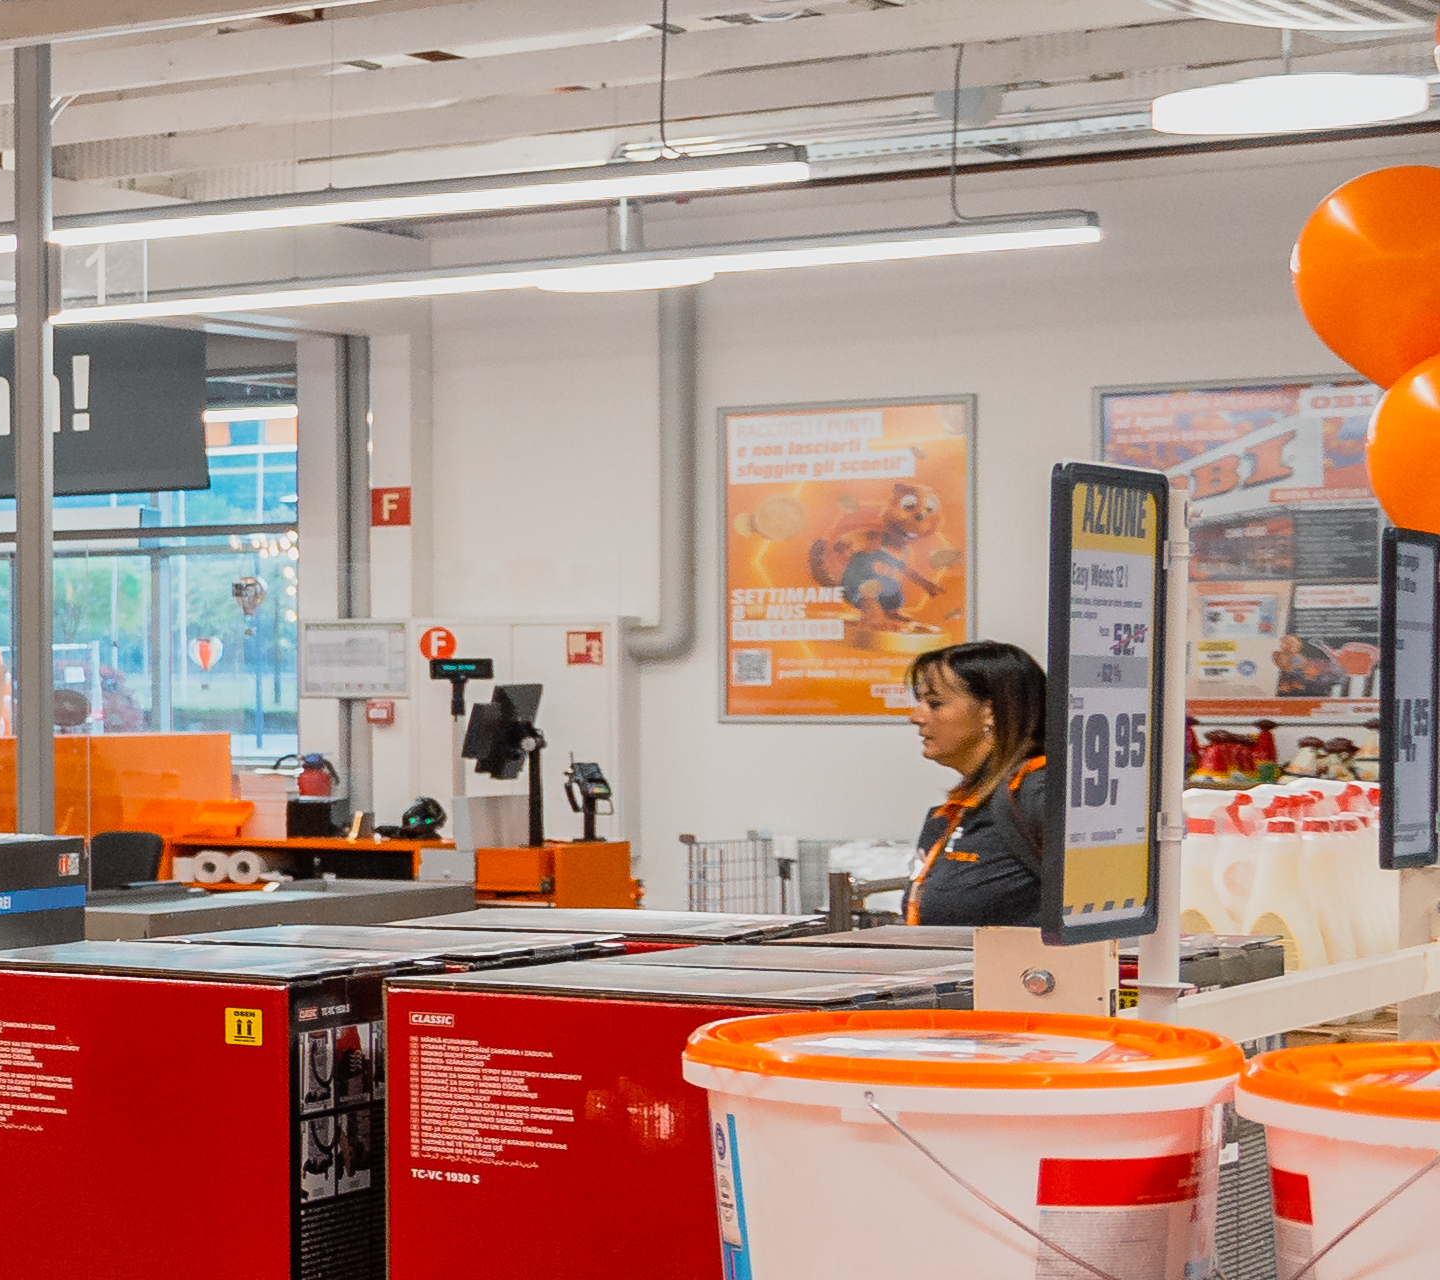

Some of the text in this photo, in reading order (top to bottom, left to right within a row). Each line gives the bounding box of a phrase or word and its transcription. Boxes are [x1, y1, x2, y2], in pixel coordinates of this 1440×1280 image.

[752, 443, 783, 457] non
[788, 439, 862, 455] lasciarti
[737, 461, 807, 478] sfuggire
[812, 460, 835, 477] gli
[383, 496, 400, 519] F
[1082, 484, 1147, 538] AZIONE
[732, 587, 845, 604] SETTIMANE
[430, 634, 448, 656] F
[1069, 713, 1147, 808] 19,95
[411, 1013, 453, 1025] CLASSIC
[411, 1168, 481, 1185] TC-VC 1930 S
